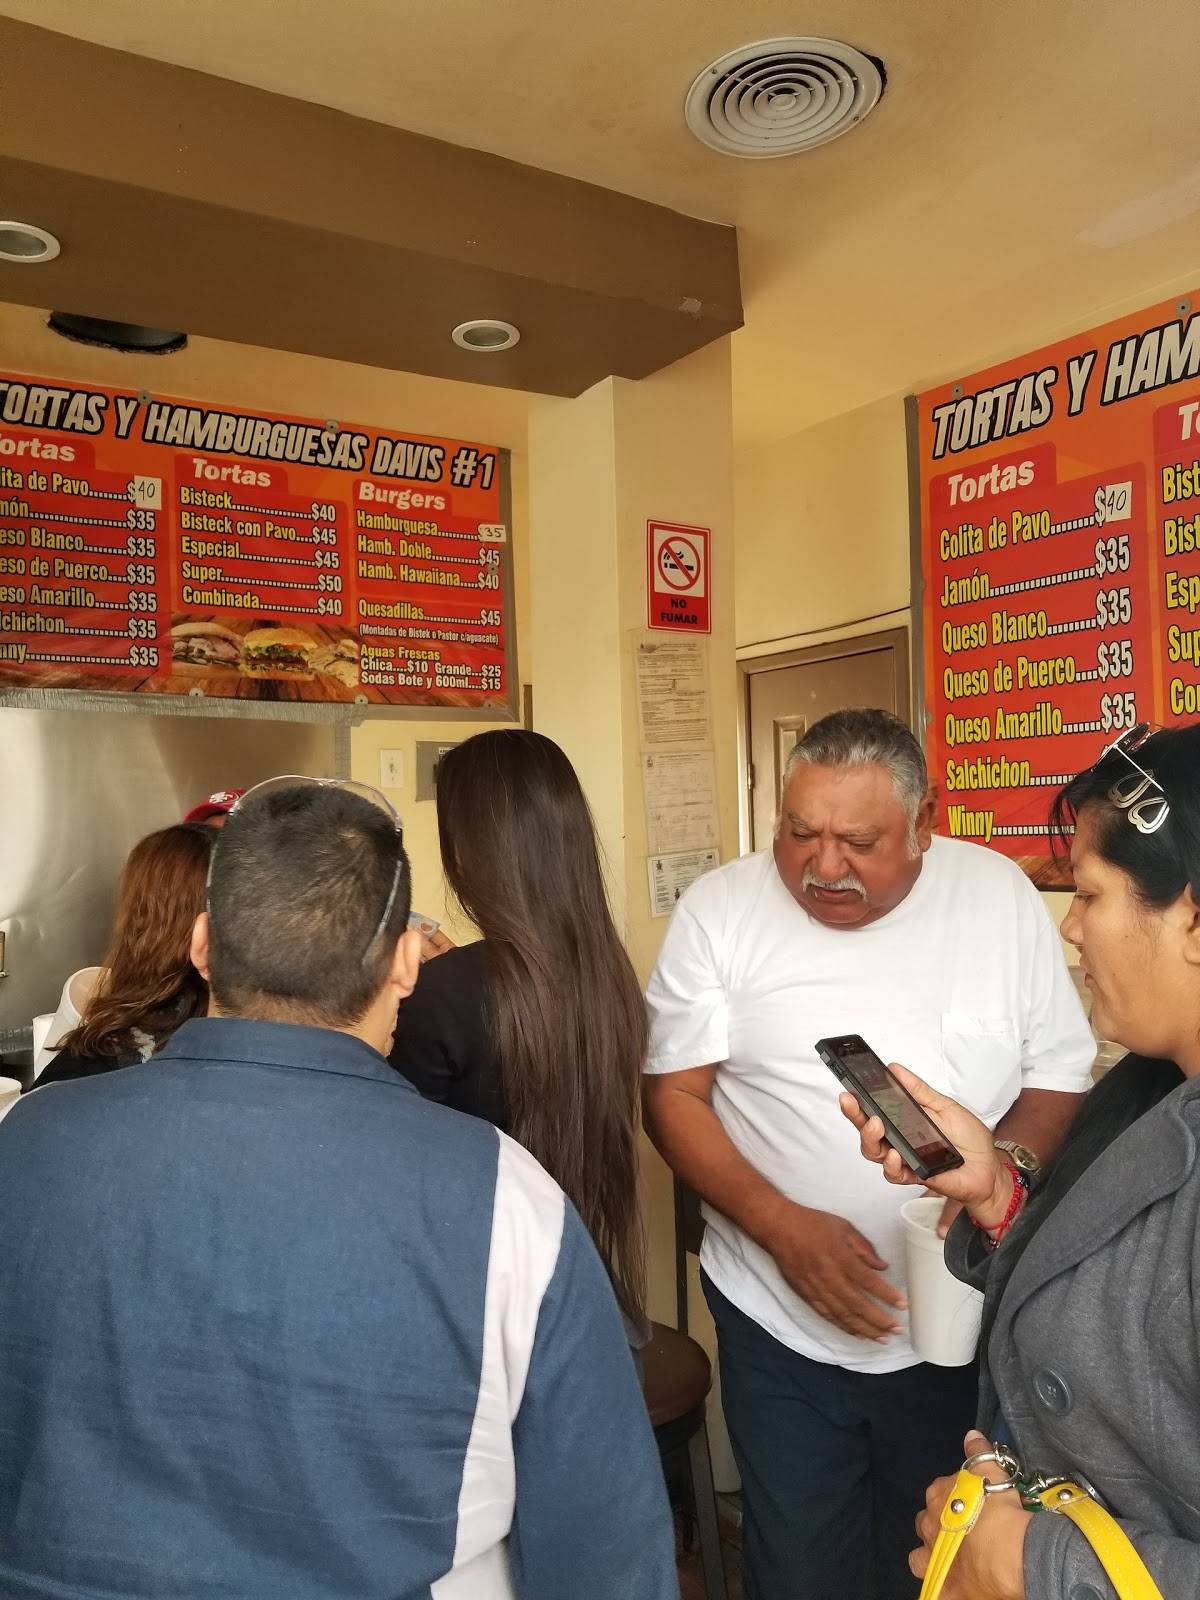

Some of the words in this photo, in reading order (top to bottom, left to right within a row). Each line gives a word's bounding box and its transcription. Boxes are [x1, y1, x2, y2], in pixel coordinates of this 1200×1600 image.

[933, 369, 1055, 459] TORTAS
[1068, 353, 1097, 415] Y
[0, 433, 75, 461] ortas
[115, 398, 137, 436] Y
[144, 403, 368, 469] HAMBURGUESAS
[371, 439, 444, 481] DAVIS
[452, 450, 494, 488] #1
[28, 471, 47, 490] de
[53, 474, 89, 496] Pavo
[193, 458, 271, 487] Tortas
[948, 460, 1035, 506] Tortas
[180, 486, 232, 509] Bisteck
[311, 503, 335, 522] $40
[359, 481, 446, 510] Burgers
[127, 509, 155, 531] $35
[181, 511, 232, 533] Bisteck
[237, 521, 260, 537] con
[266, 521, 296, 541] Pavo
[312, 527, 336, 546] $45
[357, 510, 438, 536] Hamburguesa
[31, 527, 83, 550] Blanco
[127, 537, 155, 559] $35
[358, 535, 396, 556] Hamb.
[400, 539, 432, 561] Doble
[479, 547, 500, 567] $45
[940, 524, 984, 562] Colita
[988, 516, 1007, 550] de
[1012, 510, 1051, 545] Pavo
[182, 536, 239, 558] Especial
[315, 550, 339, 569] $45
[31, 556, 48, 576] de
[55, 558, 107, 581] Puerco
[127, 563, 155, 586] $35
[182, 561, 222, 583] Super
[318, 574, 342, 593] $50
[358, 562, 397, 581] Hamb.
[400, 565, 460, 587] Hawaiiana
[478, 571, 499, 590] $40
[940, 568, 990, 608] Jamón
[1095, 535, 1130, 577] $35
[31, 584, 95, 607] Amarillo
[128, 590, 156, 613] $35
[183, 586, 260, 609] Combinada
[318, 597, 342, 616] $40
[359, 599, 424, 620] Quesadillas
[481, 609, 500, 626] $45
[671, 598, 687, 610] NO
[128, 618, 156, 640] $35
[359, 624, 397, 637] (Montadas
[398, 627, 407, 638] de
[432, 630, 437, 639] o
[438, 630, 459, 641] Pastor
[660, 612, 698, 625] FUMAR
[942, 620, 987, 655] Queso
[991, 610, 1047, 645] Blanco
[1096, 587, 1131, 630] $35
[130, 646, 158, 668] $35
[361, 644, 395, 659] Aguas
[398, 646, 441, 661] Frescas
[361, 657, 393, 672] Chica
[407, 660, 429, 674] $10
[434, 662, 472, 676] Grande
[481, 664, 501, 678] $25
[361, 670, 395, 685] Sodas
[398, 673, 423, 687] Bote
[426, 676, 433, 689] y
[435, 676, 469, 689] 600ml
[481, 677, 501, 691] $15
[943, 666, 989, 702] Queso
[993, 659, 1012, 693] de
[1017, 655, 1075, 690] Puerco
[1097, 640, 1133, 682] $35
[1170, 677, 1200, 716] Co
[945, 712, 990, 748] Queso
[995, 702, 1062, 740] Amarillo
[1101, 692, 1136, 733] $35
[946, 755, 1030, 792] Salchichon
[947, 805, 993, 843] Winny
